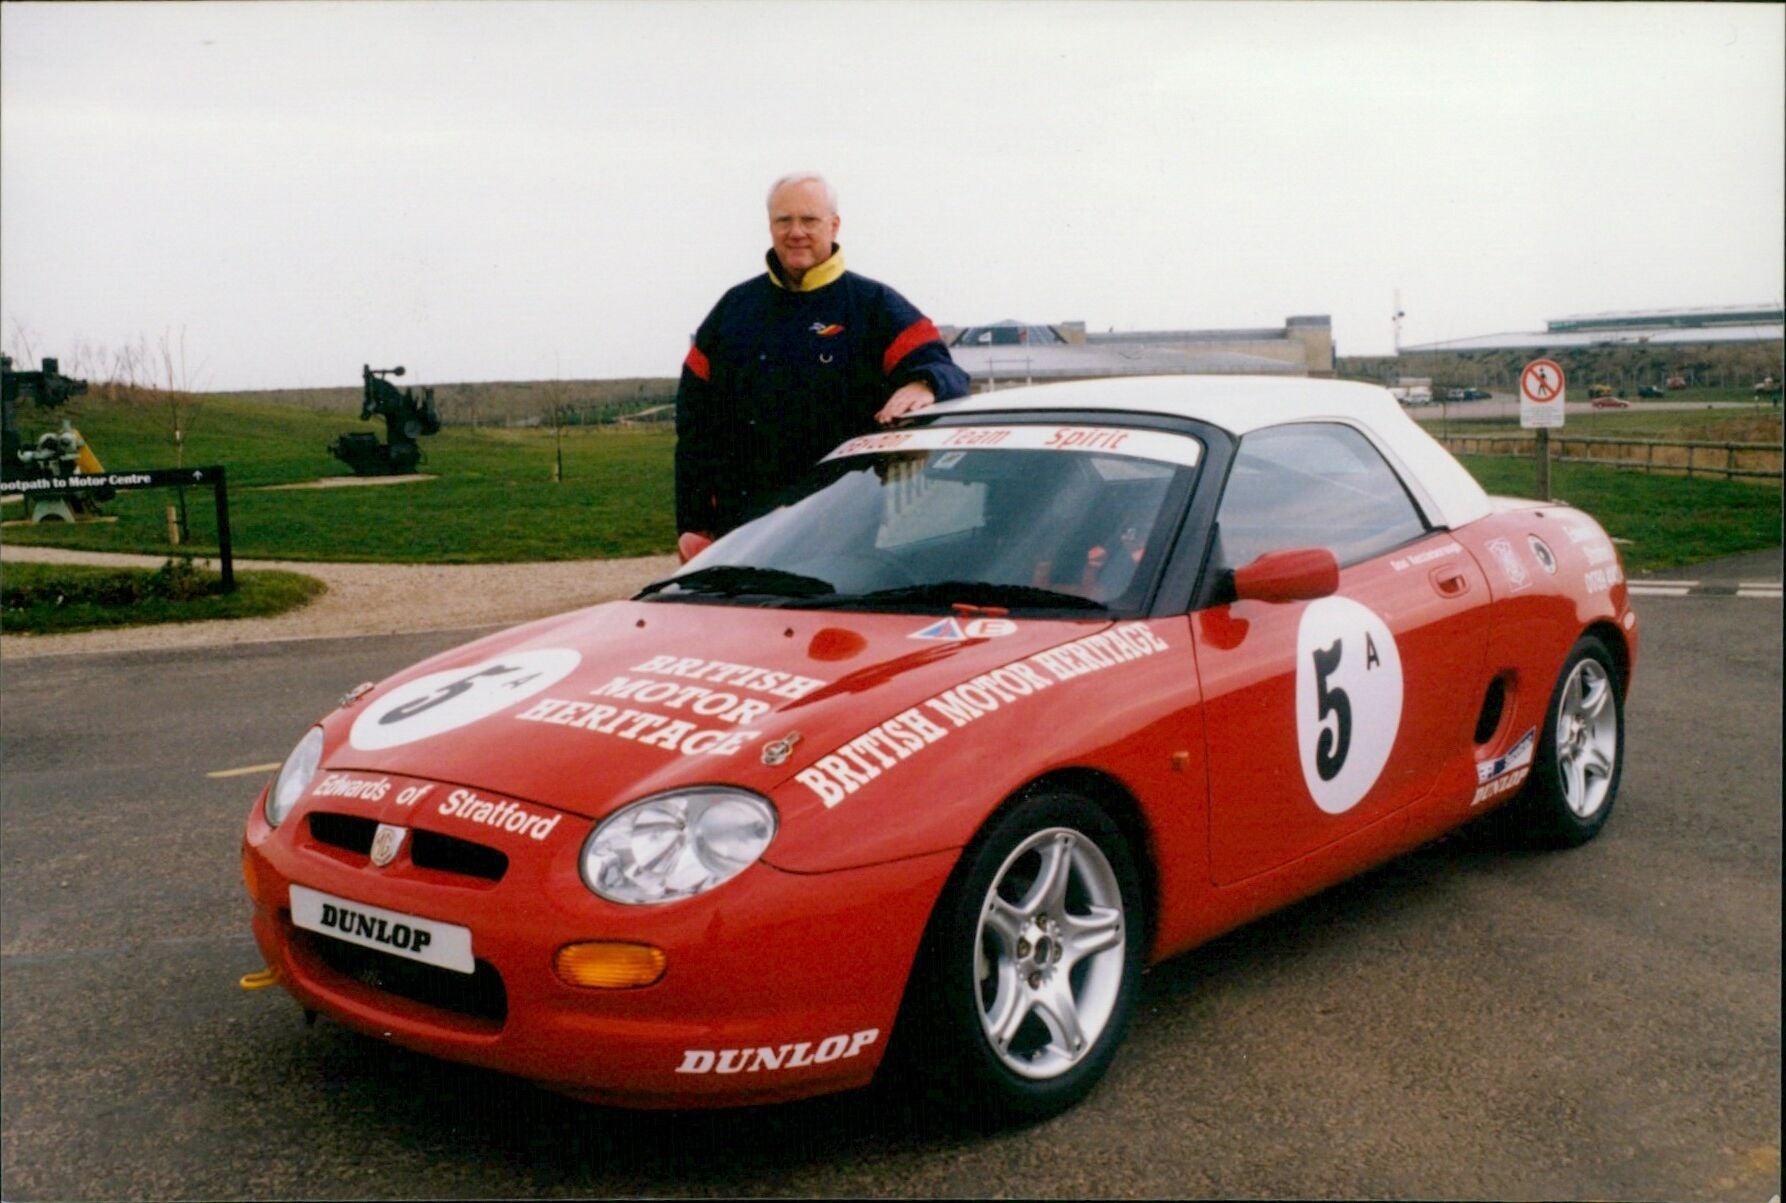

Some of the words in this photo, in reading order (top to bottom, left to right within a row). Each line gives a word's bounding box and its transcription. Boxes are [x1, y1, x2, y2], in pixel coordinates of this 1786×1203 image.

[943, 427, 1011, 446] Team
[1044, 427, 1128, 449] Spirit
[53, 478, 66, 488] to
[68, 477, 107, 487] Motor
[108, 474, 152, 485] Centre
[377, 664, 524, 725] 5
[501, 672, 544, 689] A
[590, 676, 772, 726] MOTOR
[630, 655, 828, 699] BRITISH
[515, 698, 763, 757] HERITAGE
[795, 706, 949, 810] BRITISH
[924, 660, 1056, 728] MOTOR
[1030, 621, 1170, 682] HERITAGE
[1313, 638, 1353, 782] 5
[1365, 631, 1381, 671] A
[312, 774, 391, 802] Edwards
[396, 784, 435, 806] of
[438, 788, 562, 841] Stratford
[320, 903, 432, 953] DUNLOP
[674, 1028, 880, 1074] DUNLOP
